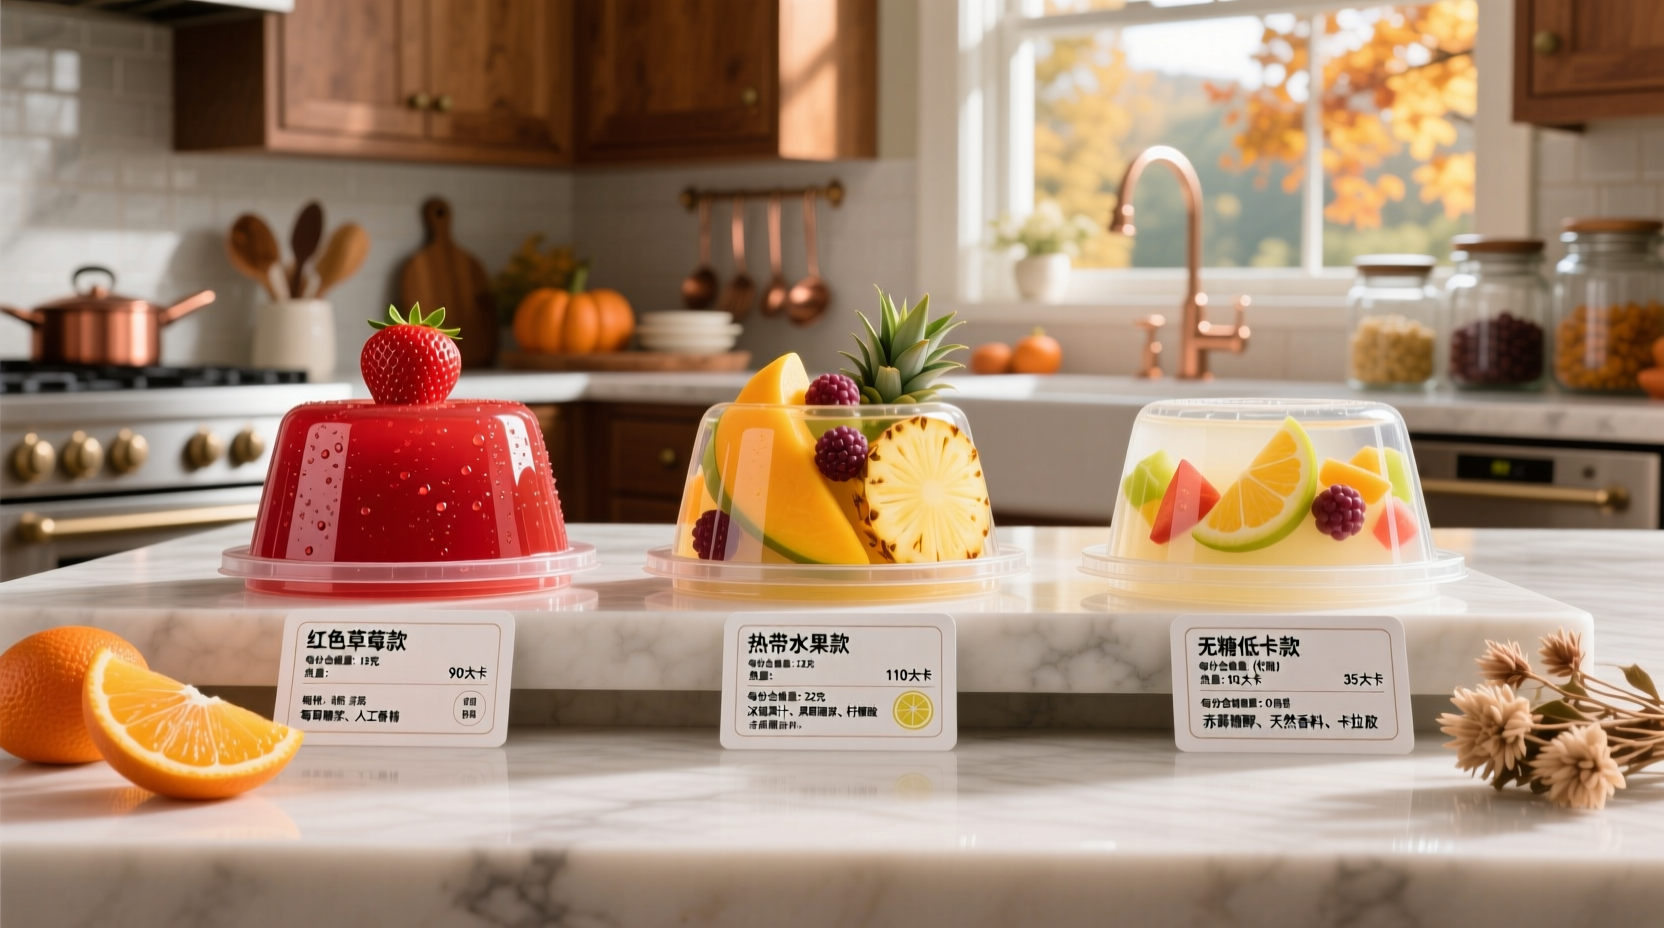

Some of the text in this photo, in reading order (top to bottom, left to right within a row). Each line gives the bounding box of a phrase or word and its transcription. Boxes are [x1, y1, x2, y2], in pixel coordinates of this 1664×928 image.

[306, 628, 408, 652] 红色草莓款
[747, 631, 850, 654] 热带水果款
[1198, 634, 1300, 657] 无糖低卡款
[448, 666, 488, 680] 90大卡
[886, 668, 933, 682] 110大卡
[1343, 672, 1384, 687] 35大卡
